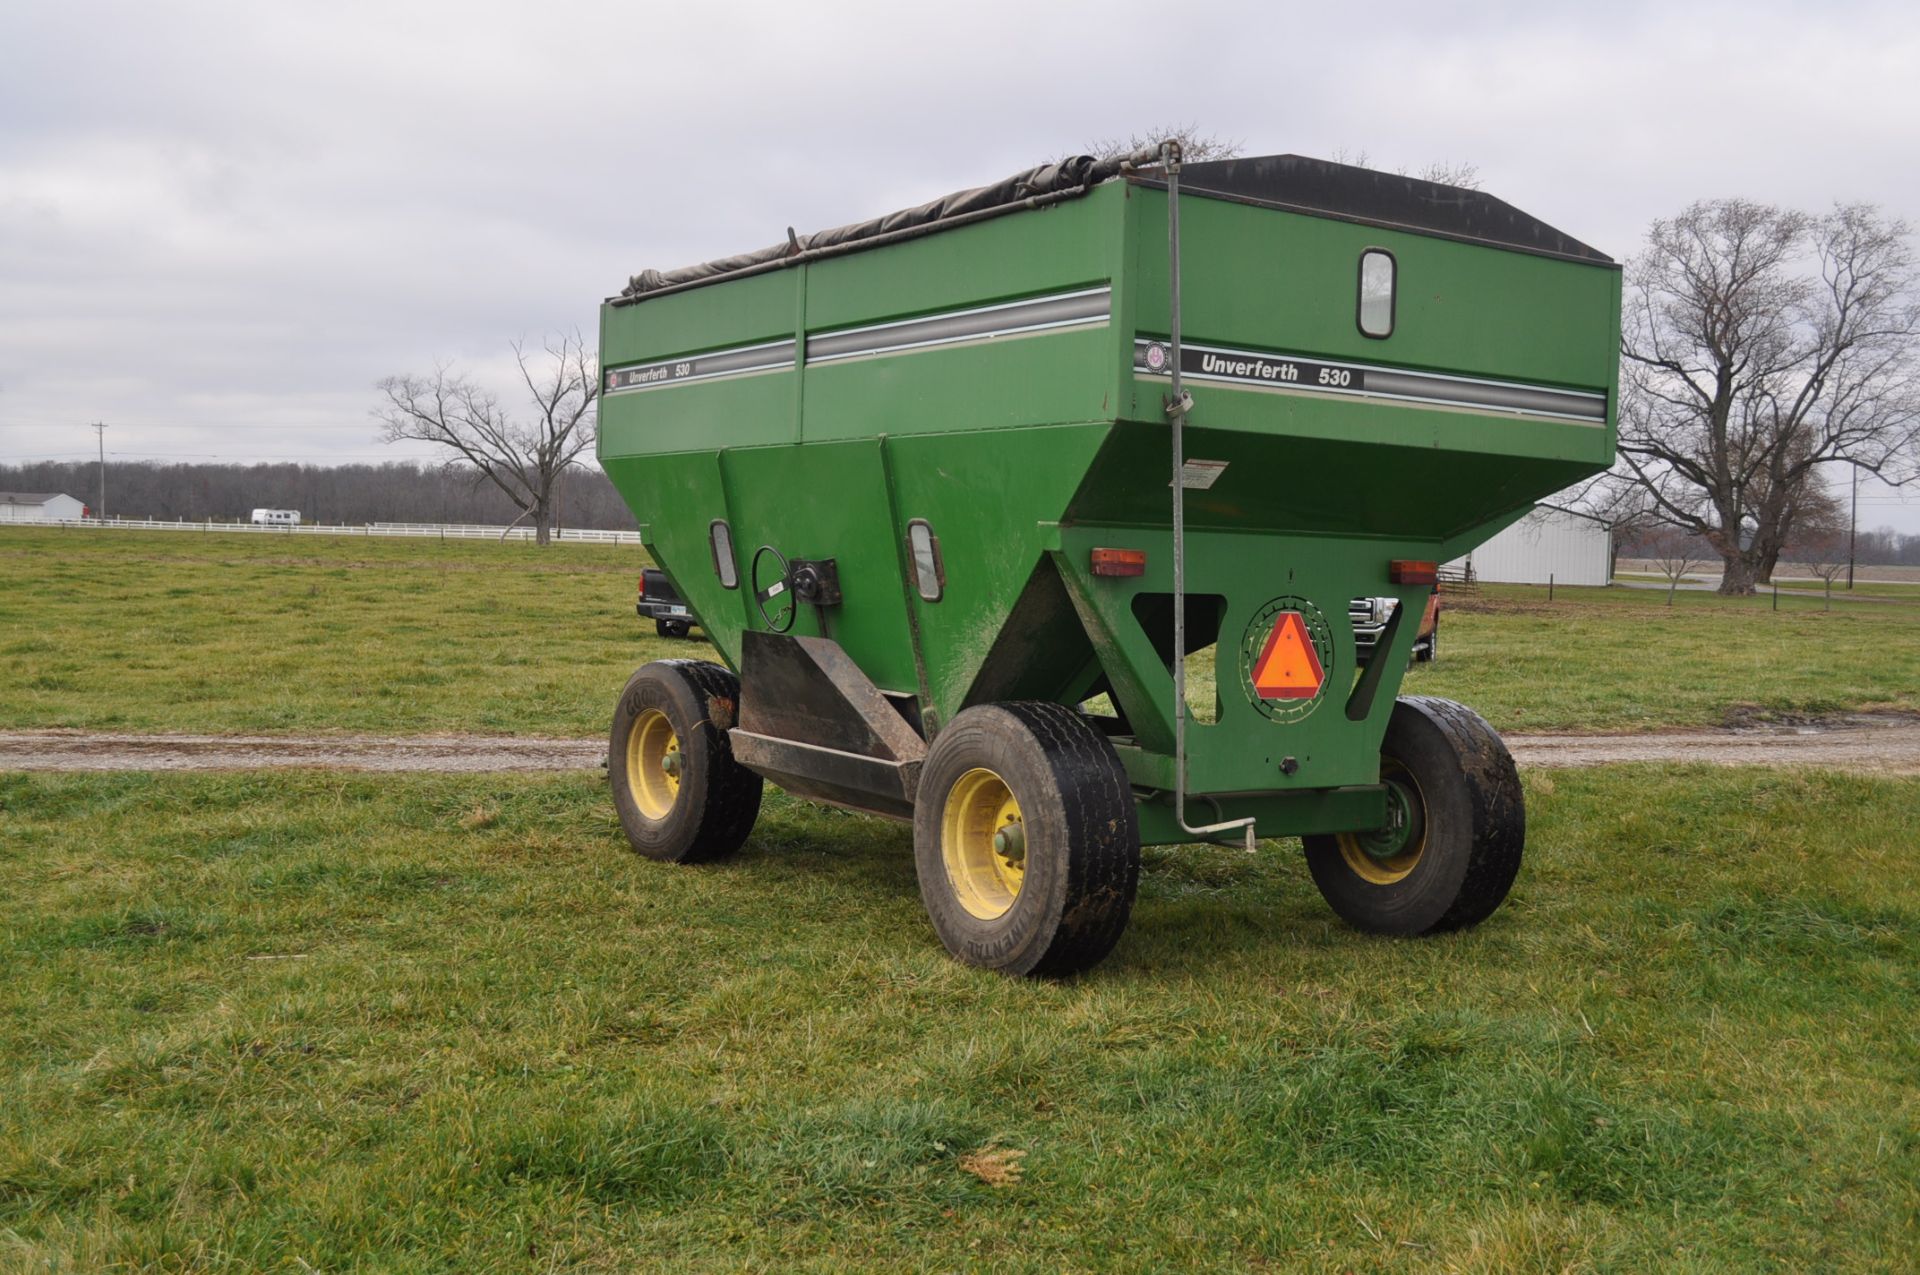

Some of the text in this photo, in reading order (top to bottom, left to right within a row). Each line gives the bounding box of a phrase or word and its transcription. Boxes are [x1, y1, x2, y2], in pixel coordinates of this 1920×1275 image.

[629, 366, 668, 384] Unverferth
[675, 362, 690, 377] 530
[1202, 354, 1351, 387] Unverferth 530
